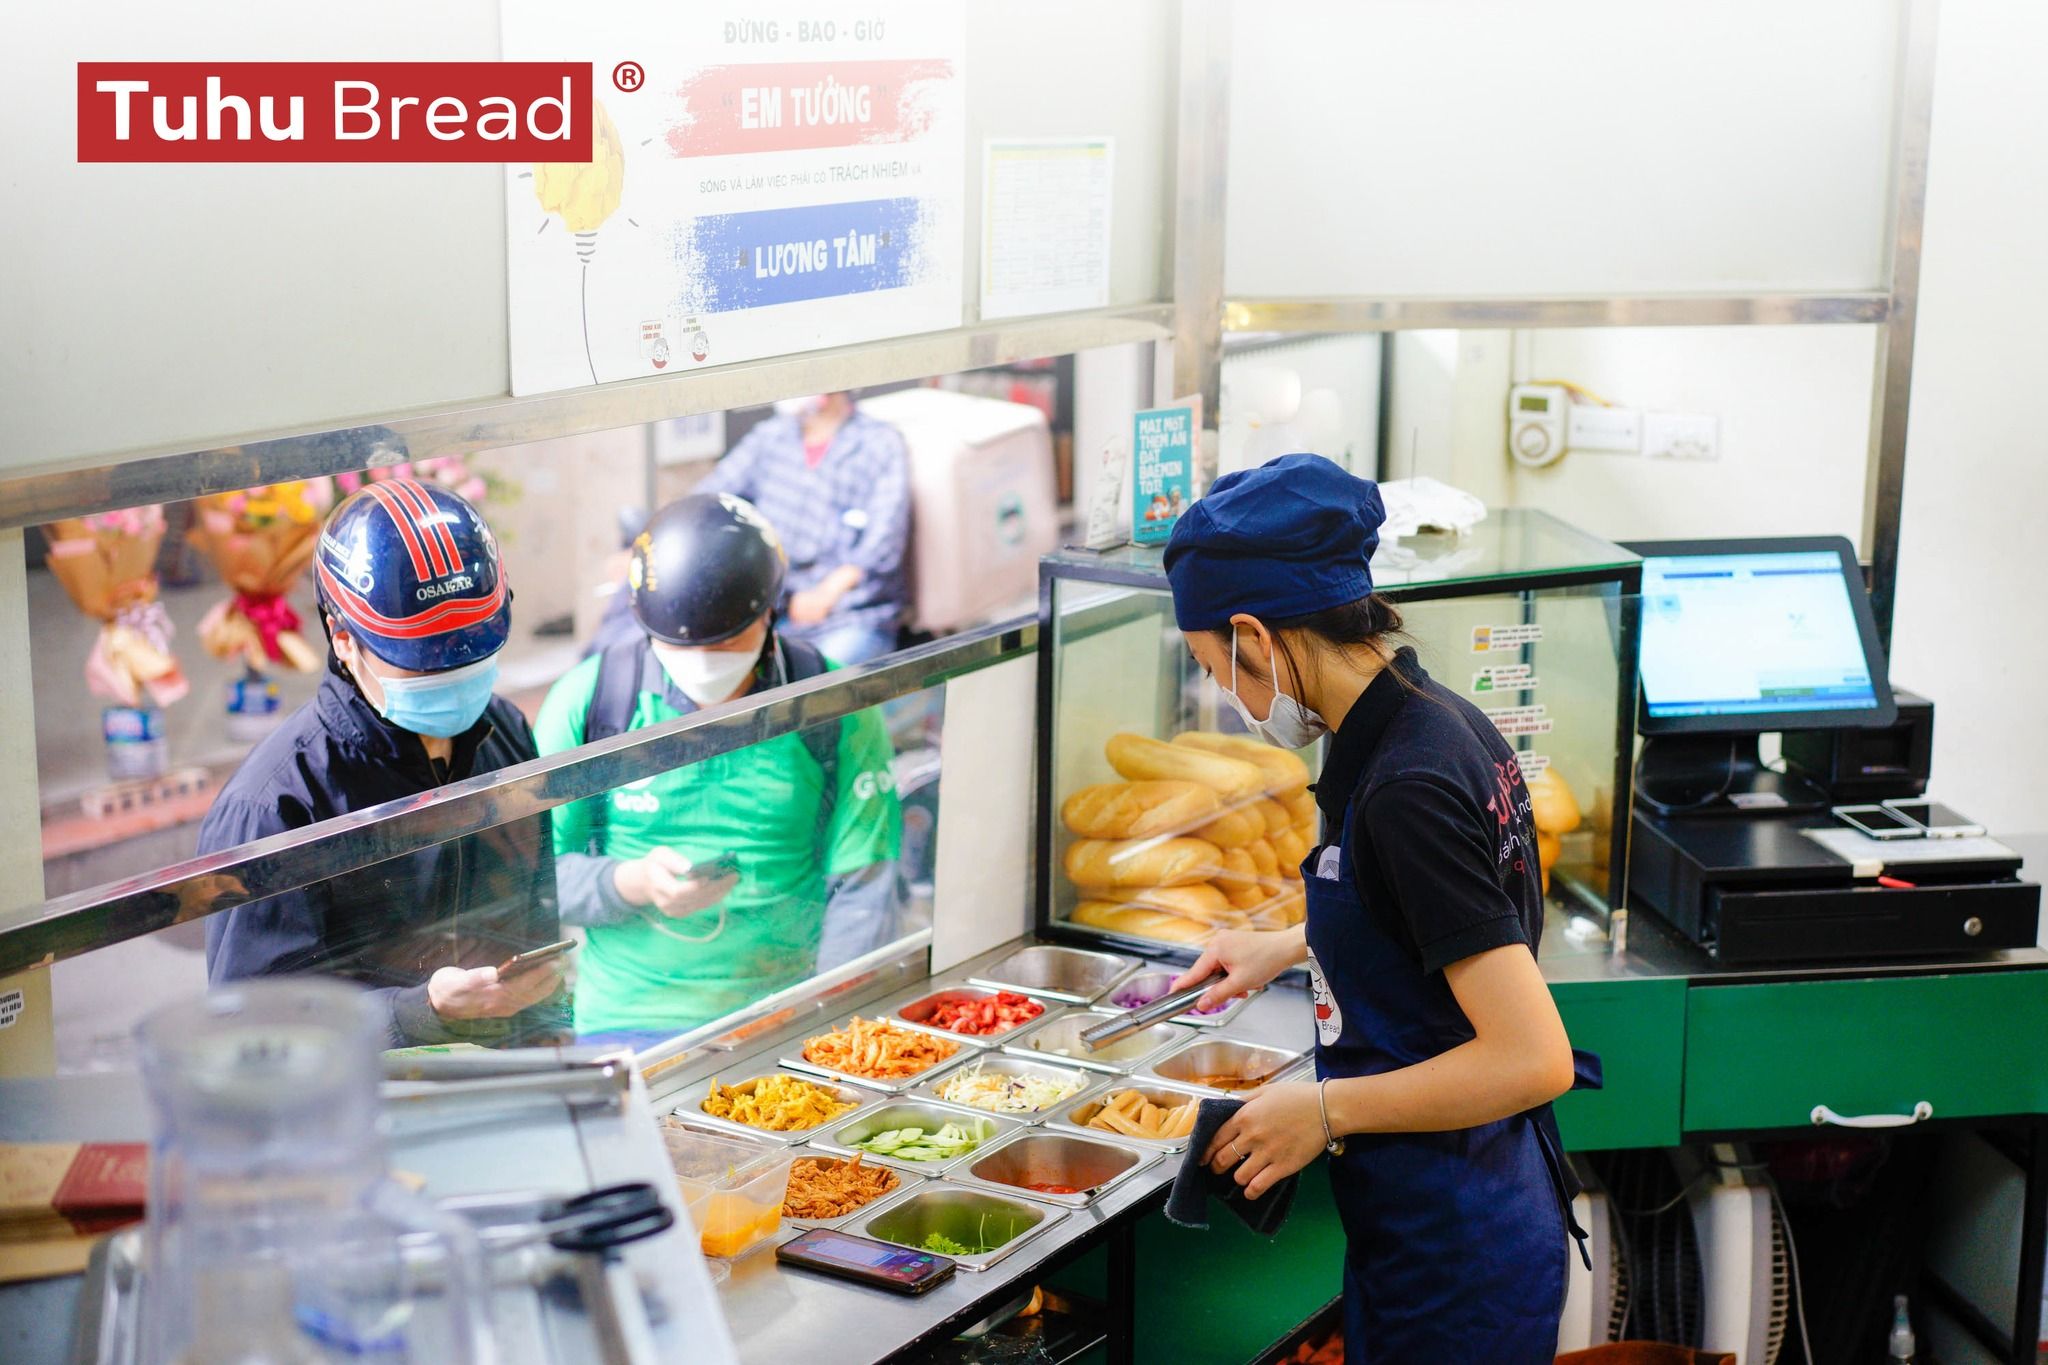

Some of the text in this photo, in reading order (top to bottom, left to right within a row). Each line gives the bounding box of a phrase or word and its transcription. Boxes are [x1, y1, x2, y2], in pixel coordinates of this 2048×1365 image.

[724, 17, 779, 43] ĐỪNG
[798, 21, 836, 42] BAO
[855, 17, 886, 41] GIỜ
[741, 74, 871, 128] EM TƯỞNG
[829, 162, 869, 183] TRÁCH
[755, 228, 876, 279] LƯƠNG TÂM
